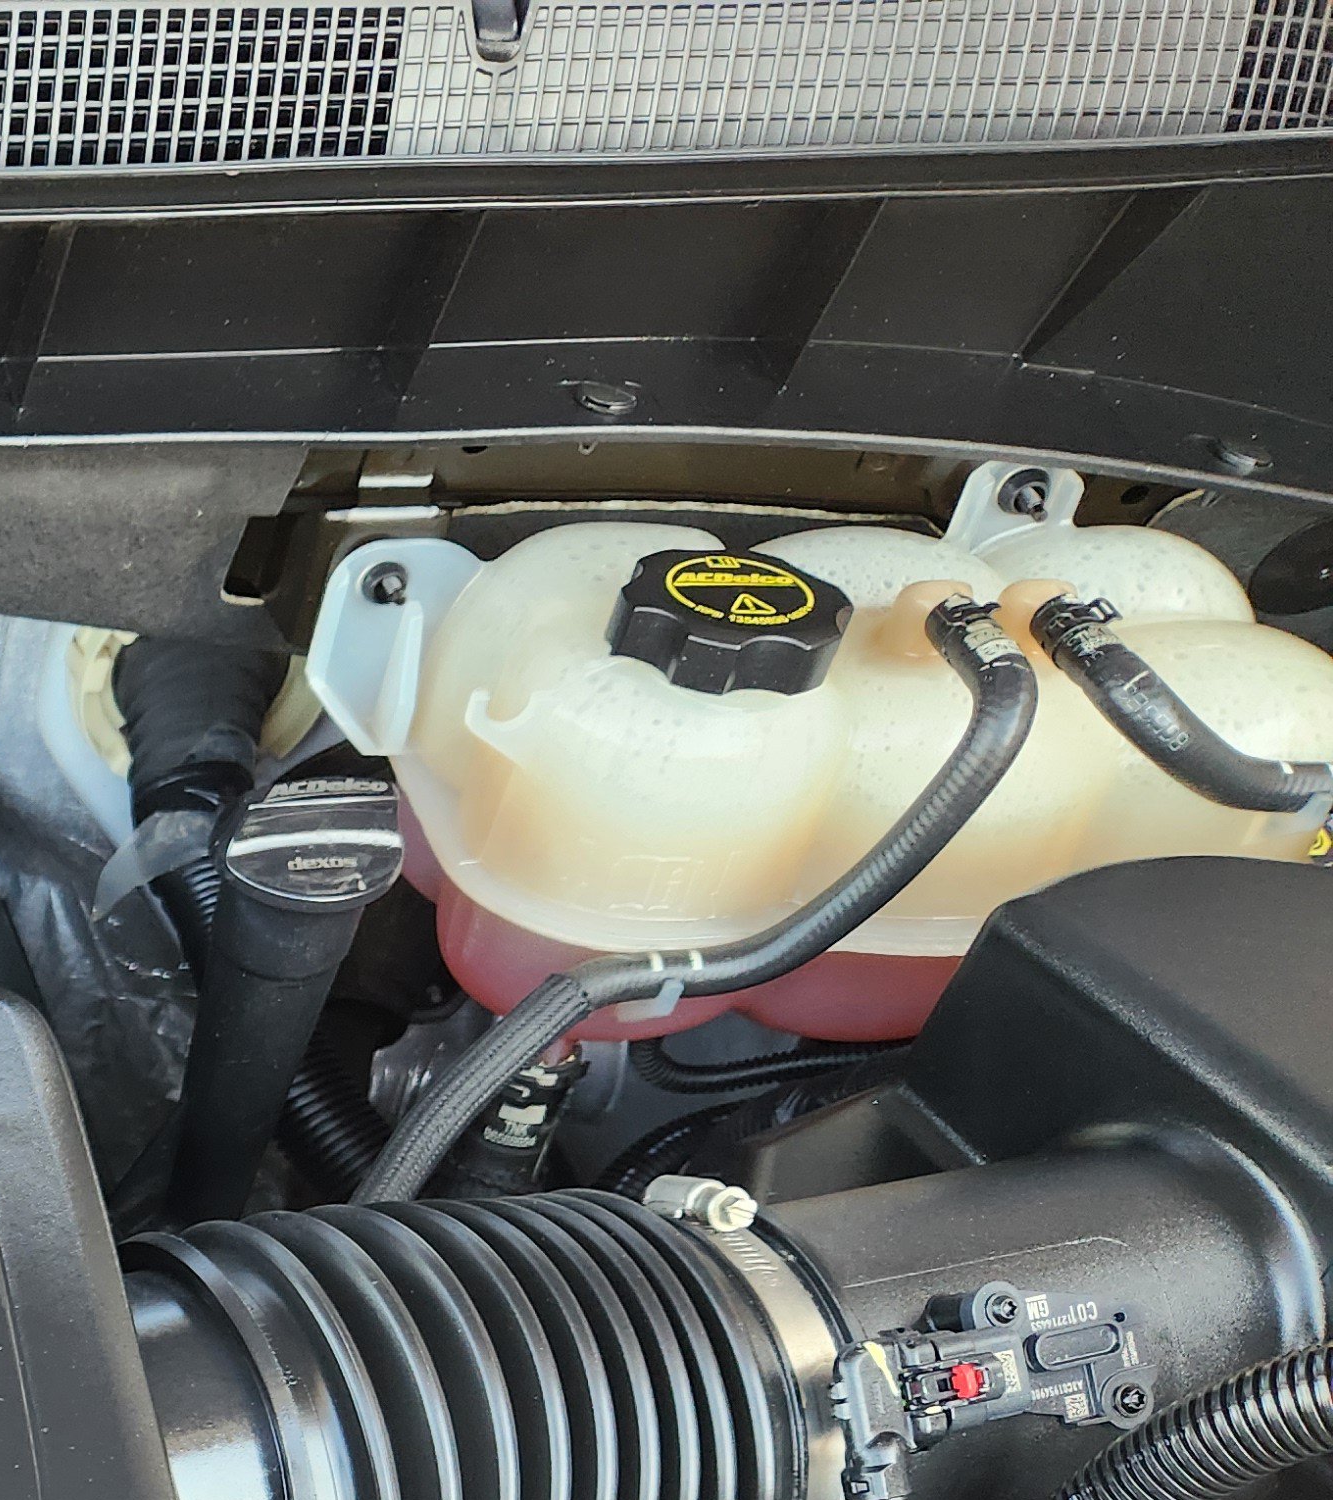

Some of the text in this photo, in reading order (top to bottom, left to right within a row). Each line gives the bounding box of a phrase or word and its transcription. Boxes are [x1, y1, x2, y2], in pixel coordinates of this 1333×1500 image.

[674, 571, 795, 587] ACDelco
[265, 777, 389, 800] ACDelco
[287, 856, 358, 871] dexos
[1026, 1300, 1050, 1321] GM
